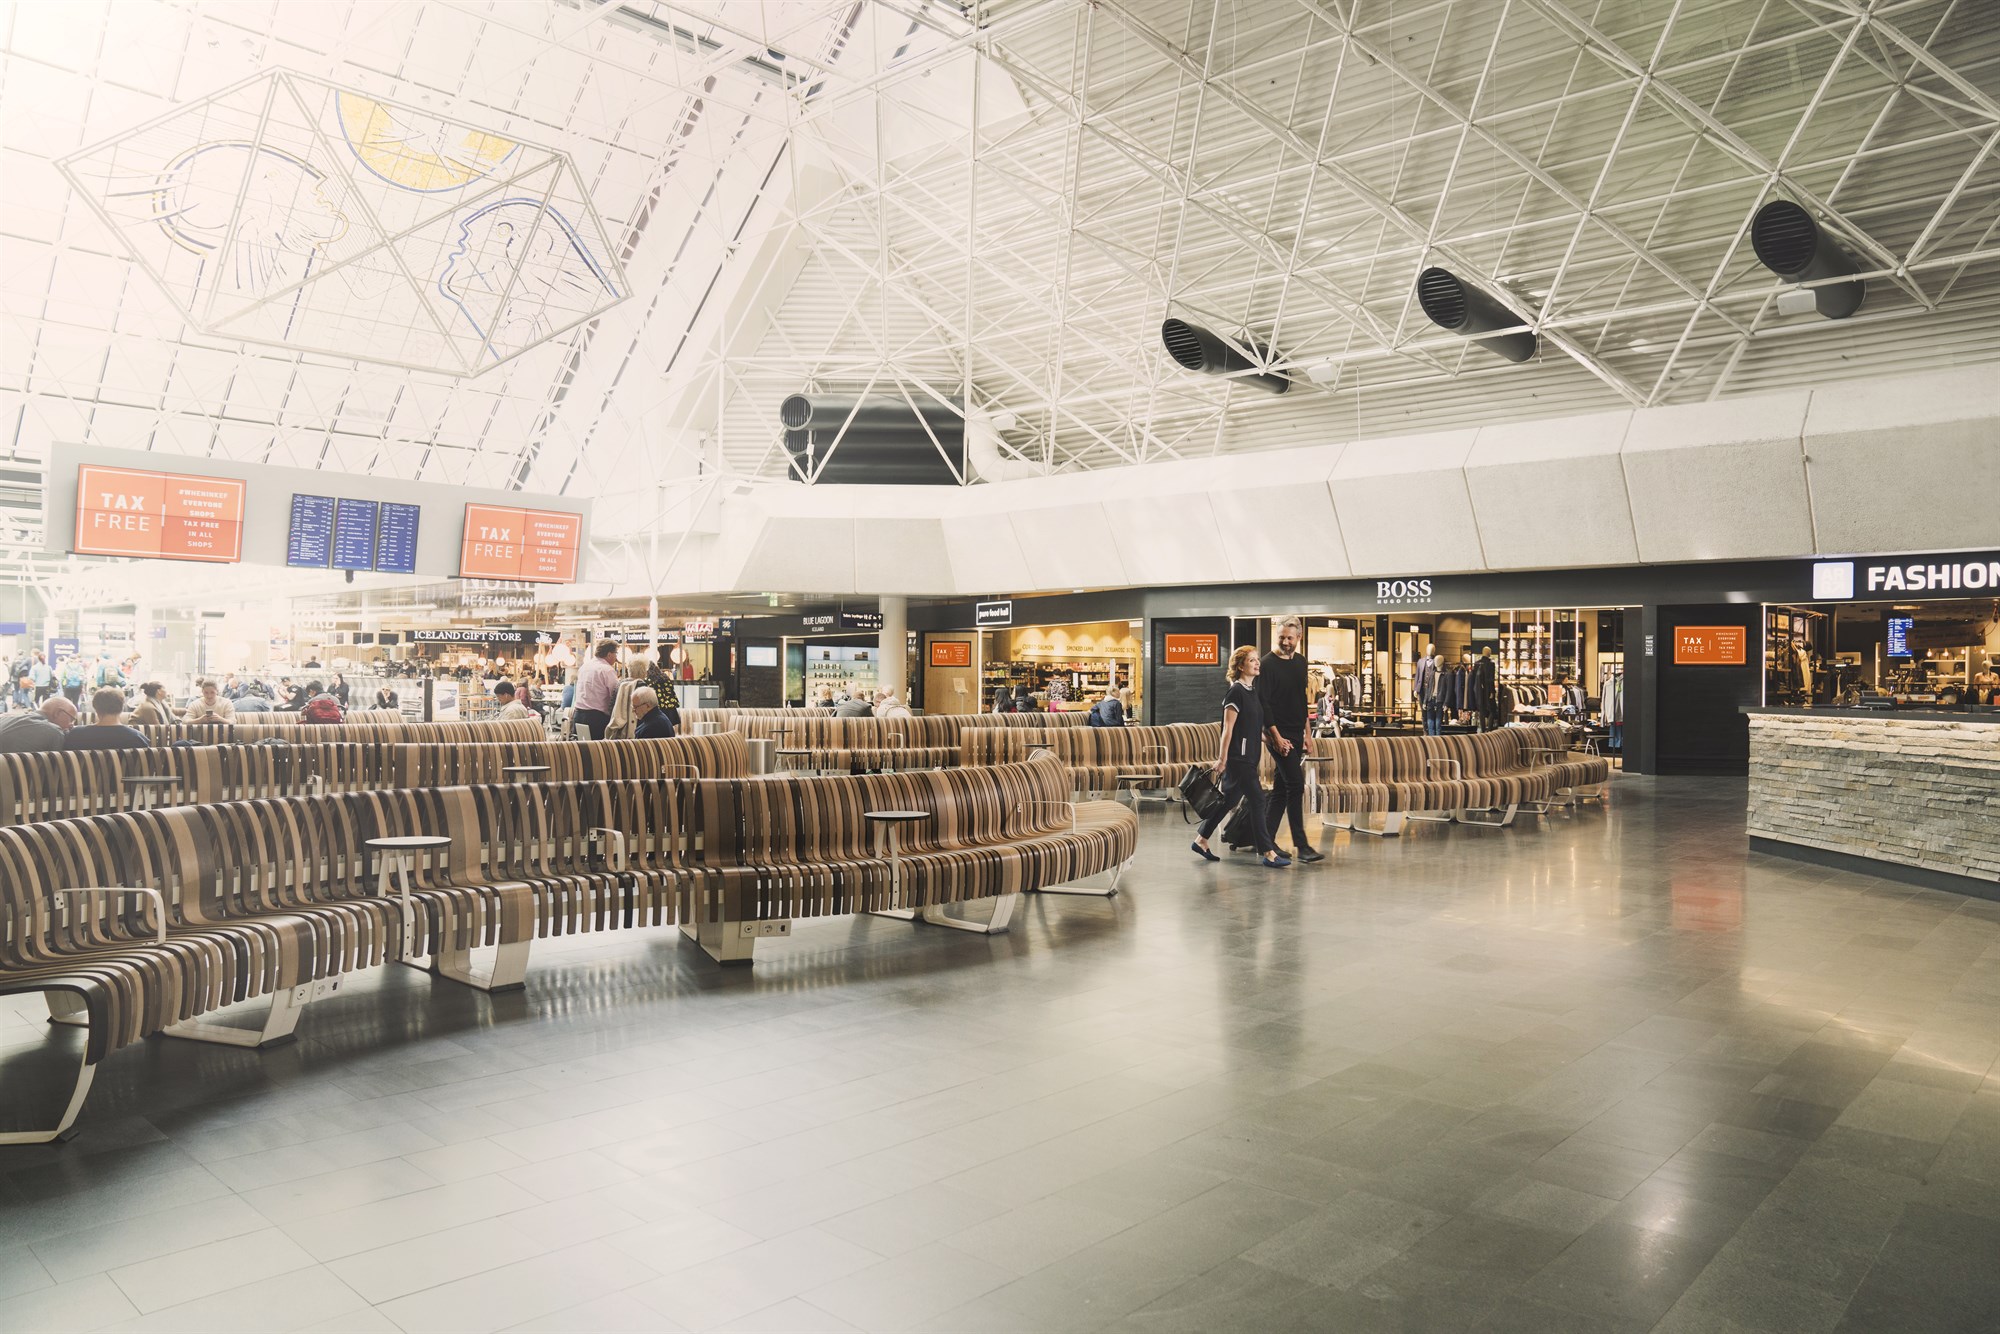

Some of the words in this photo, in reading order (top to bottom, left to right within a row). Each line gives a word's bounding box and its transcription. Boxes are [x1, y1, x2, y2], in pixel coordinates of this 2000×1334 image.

[179, 489, 228, 499] #WHENINKEF
[101, 493, 144, 510] TAX
[183, 500, 223, 508] EVERYONE
[189, 510, 215, 518] SHOPS
[94, 512, 150, 532] FREE
[480, 526, 510, 541] TAX
[474, 544, 514, 558] FREE
[1377, 580, 1432, 598] BOSS
[462, 596, 539, 608] RESTAURANT
[979, 610, 989, 619] pure
[989, 608, 1000, 617] food
[803, 617, 814, 625] BLUE
[815, 616, 833, 624] LAGOON
[414, 630, 461, 640] ICELAND
[462, 631, 487, 641] GIFT
[488, 632, 522, 642] STORE
